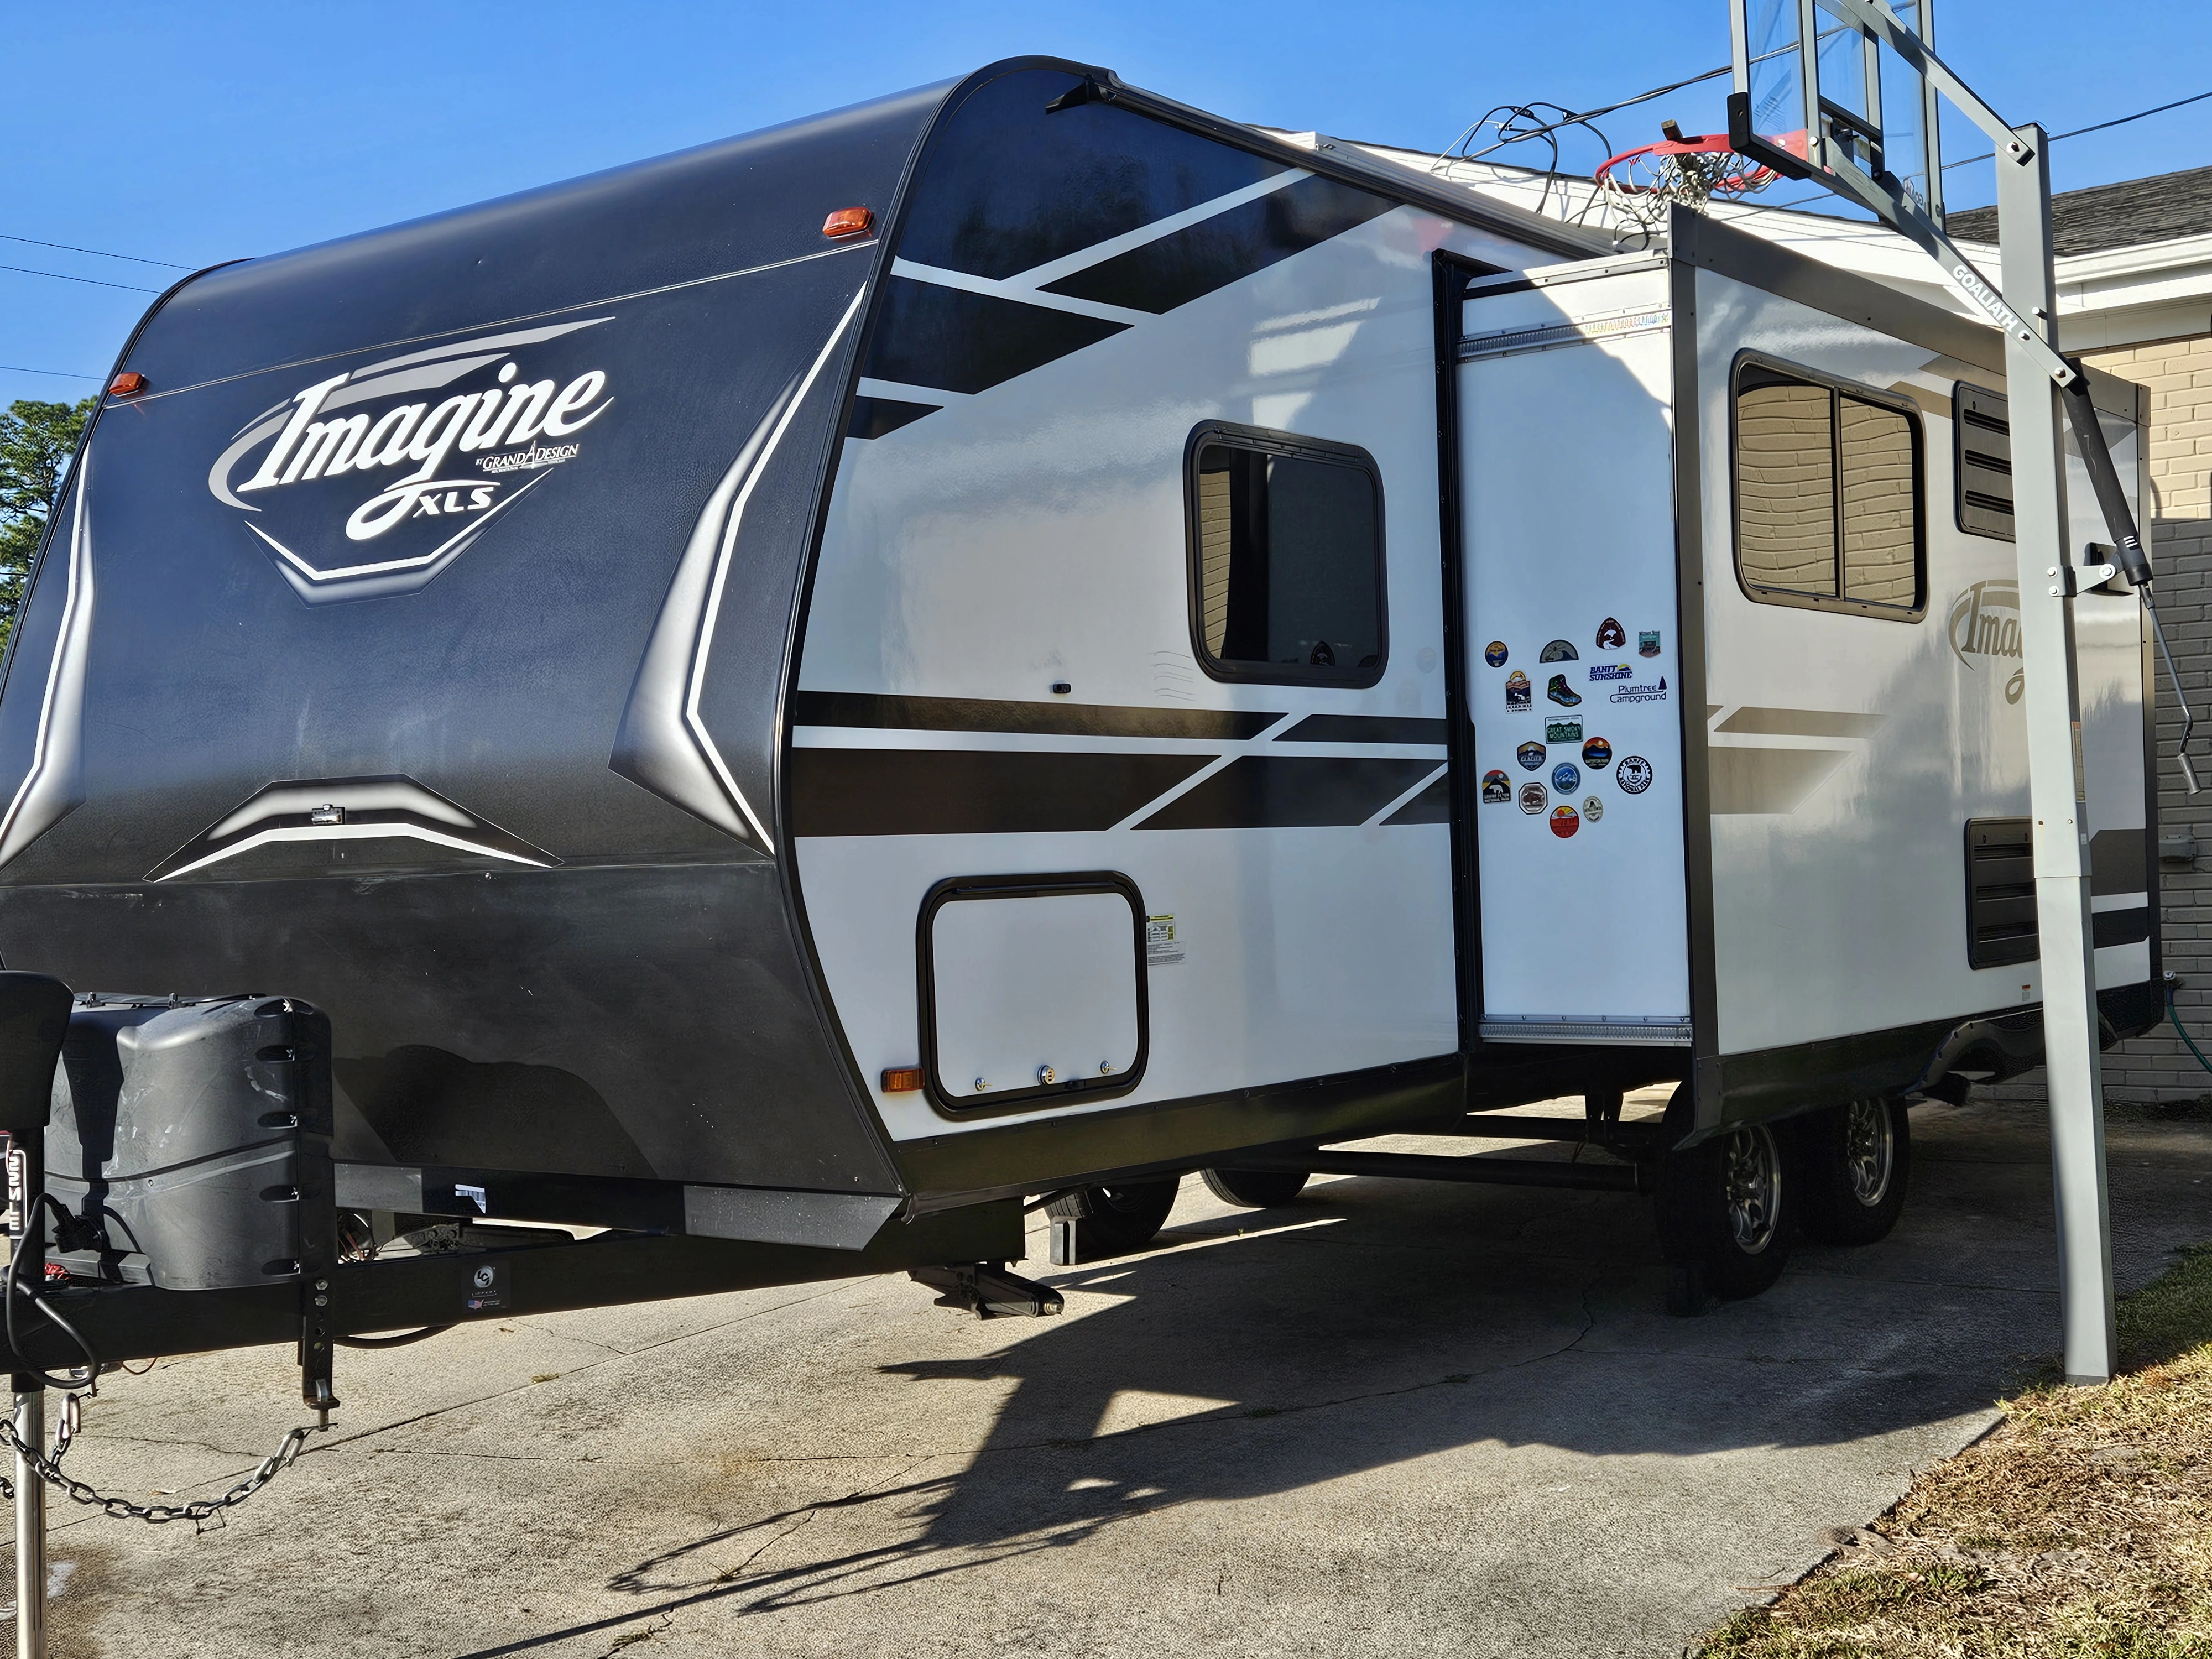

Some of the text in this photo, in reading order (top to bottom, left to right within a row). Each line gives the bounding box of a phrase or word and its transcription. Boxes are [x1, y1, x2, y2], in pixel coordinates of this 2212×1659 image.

[1953, 265, 2018, 332] GOALIATH
[236, 362, 615, 540] Imagine
[482, 453, 525, 469] GRAND
[535, 444, 579, 461] DESIGN
[412, 487, 494, 518] XLS
[1589, 671, 1632, 681] SUNSHINE
[1619, 685, 1656, 693] Plumtree
[1610, 692, 1666, 703] Campground
[8, 1156, 22, 1231] 22MLE
